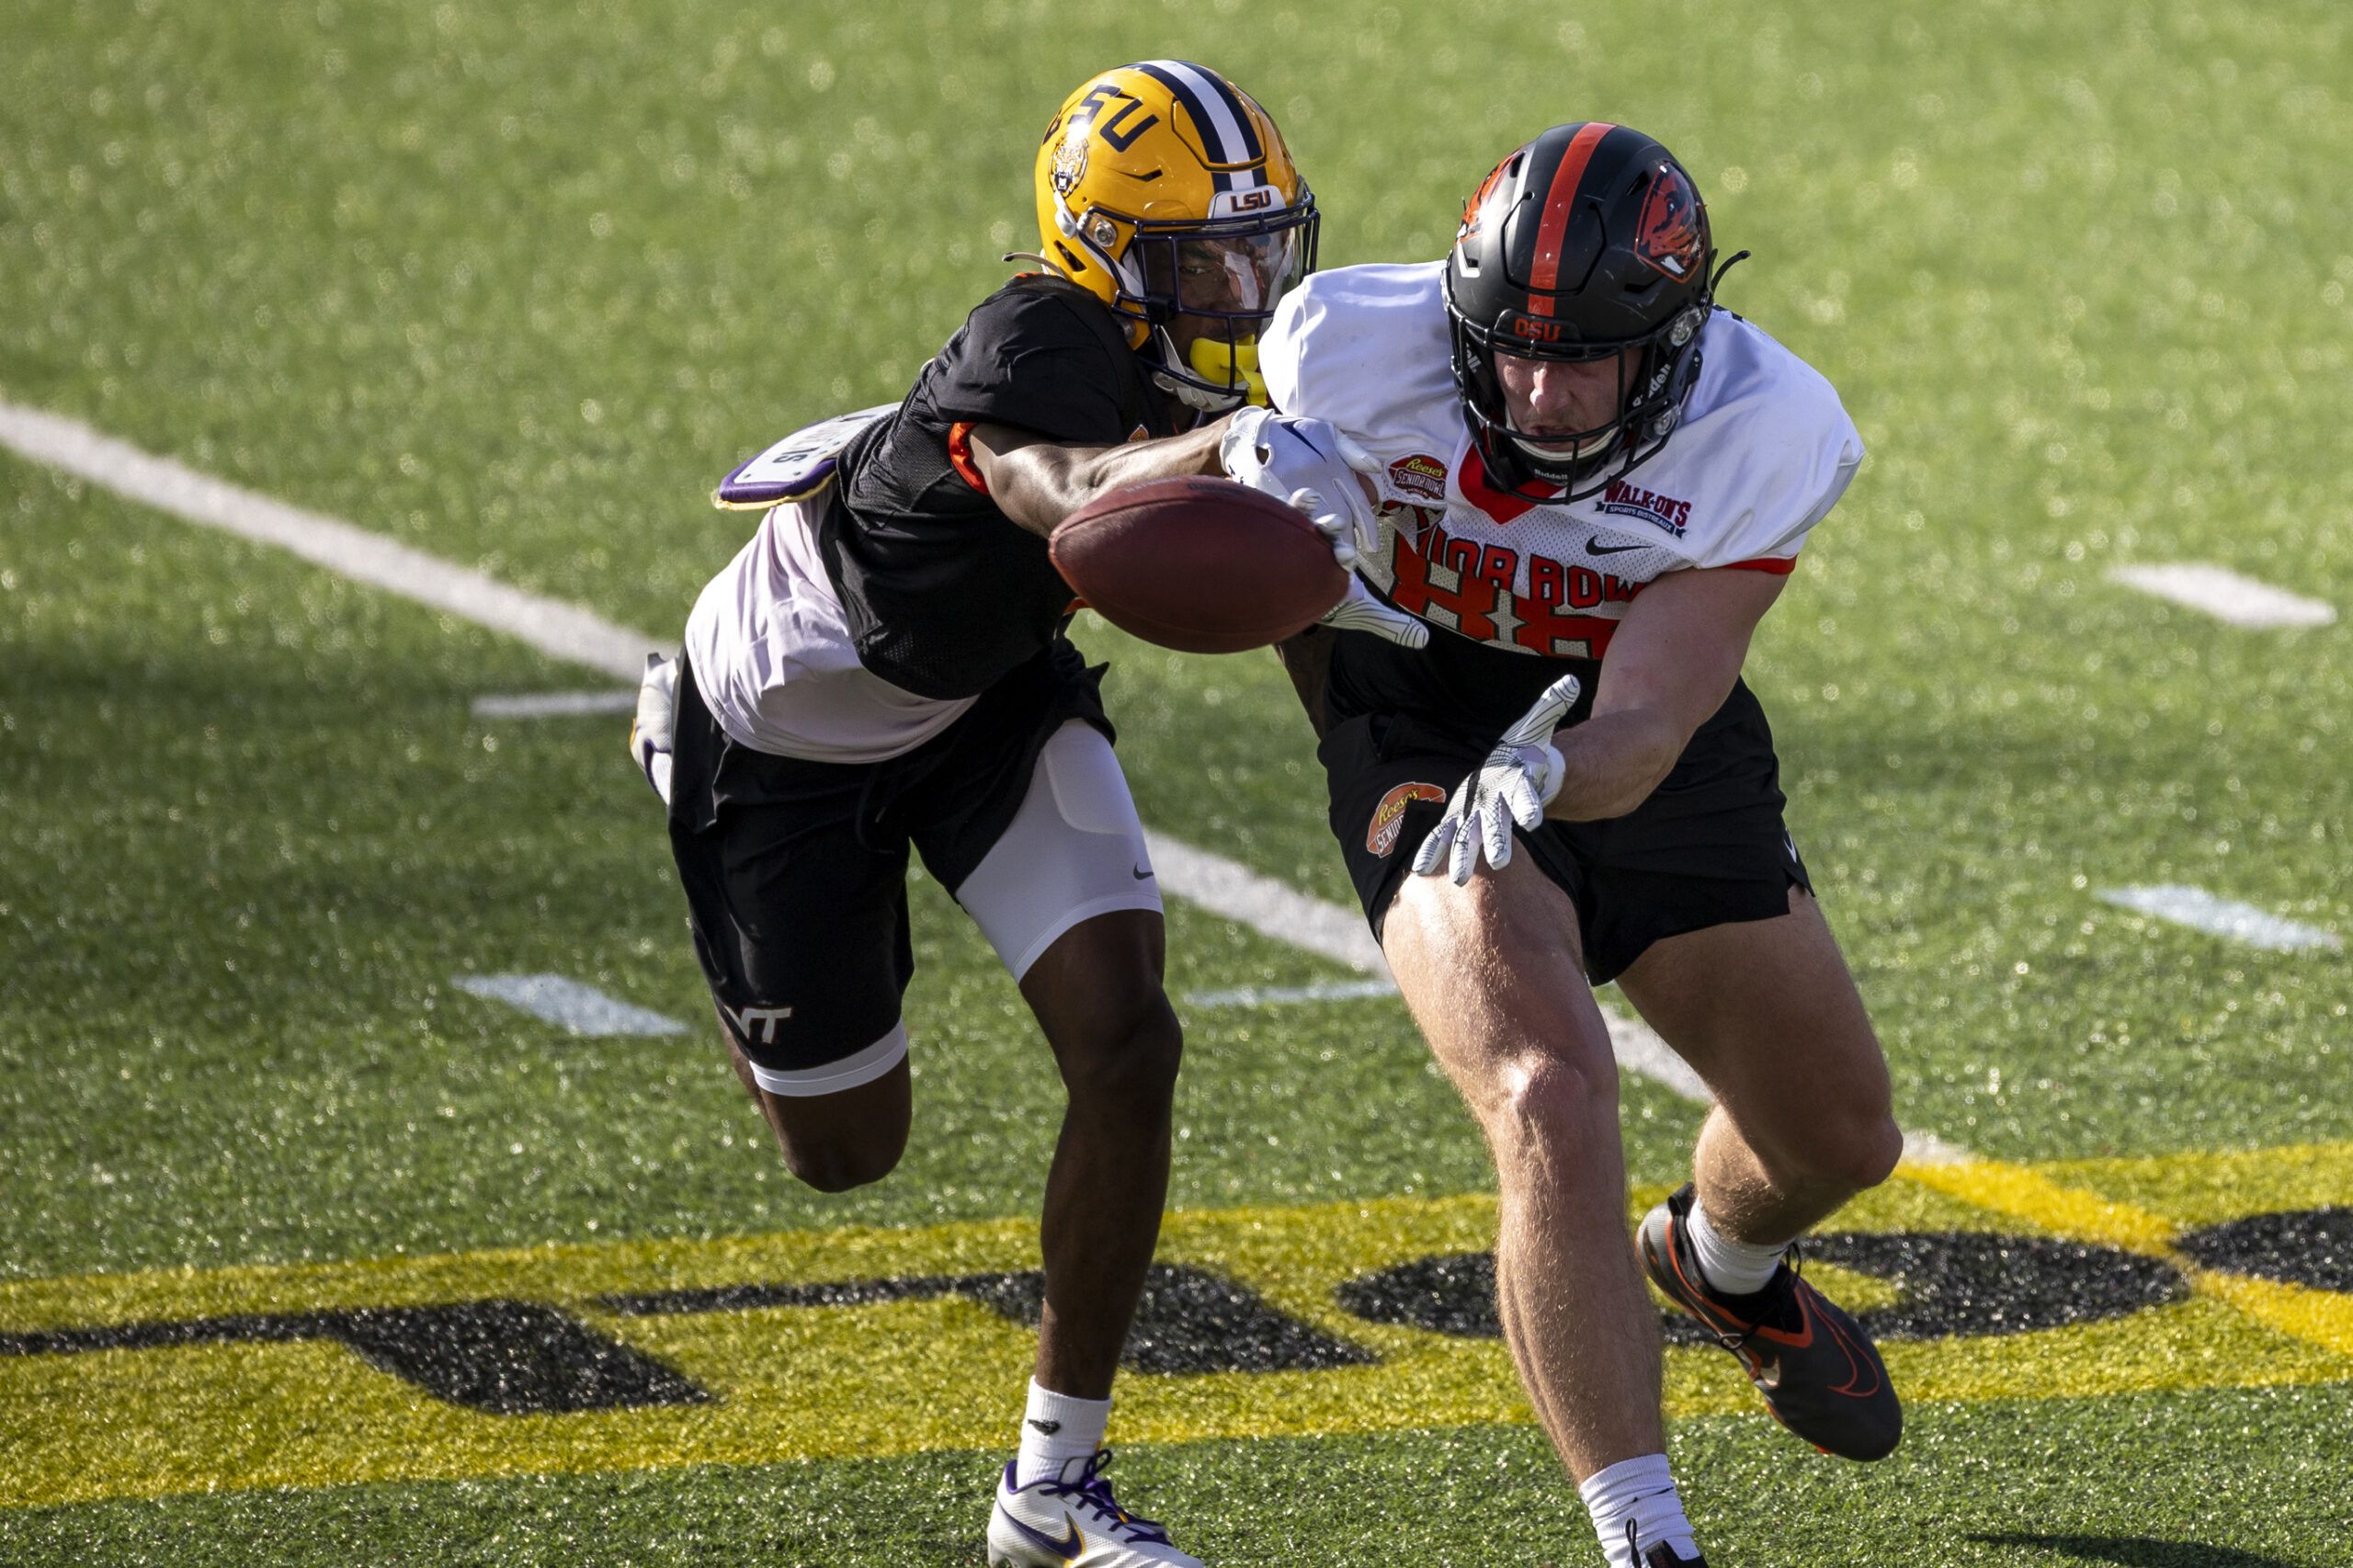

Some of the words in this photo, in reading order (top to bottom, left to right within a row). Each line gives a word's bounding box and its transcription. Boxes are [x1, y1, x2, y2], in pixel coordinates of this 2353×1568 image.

[1230, 189, 1271, 212] LSU
[1515, 317, 1560, 342] OSU
[1405, 458, 1445, 478] Reese's
[1534, 468, 1568, 480] Riddell
[1396, 470, 1426, 489] SENIOR
[1425, 479, 1444, 497] BOWL
[1608, 505, 1636, 516] SPORTS
[1637, 509, 1673, 531] BISTREAUX
[1529, 553, 1645, 608] BOW
